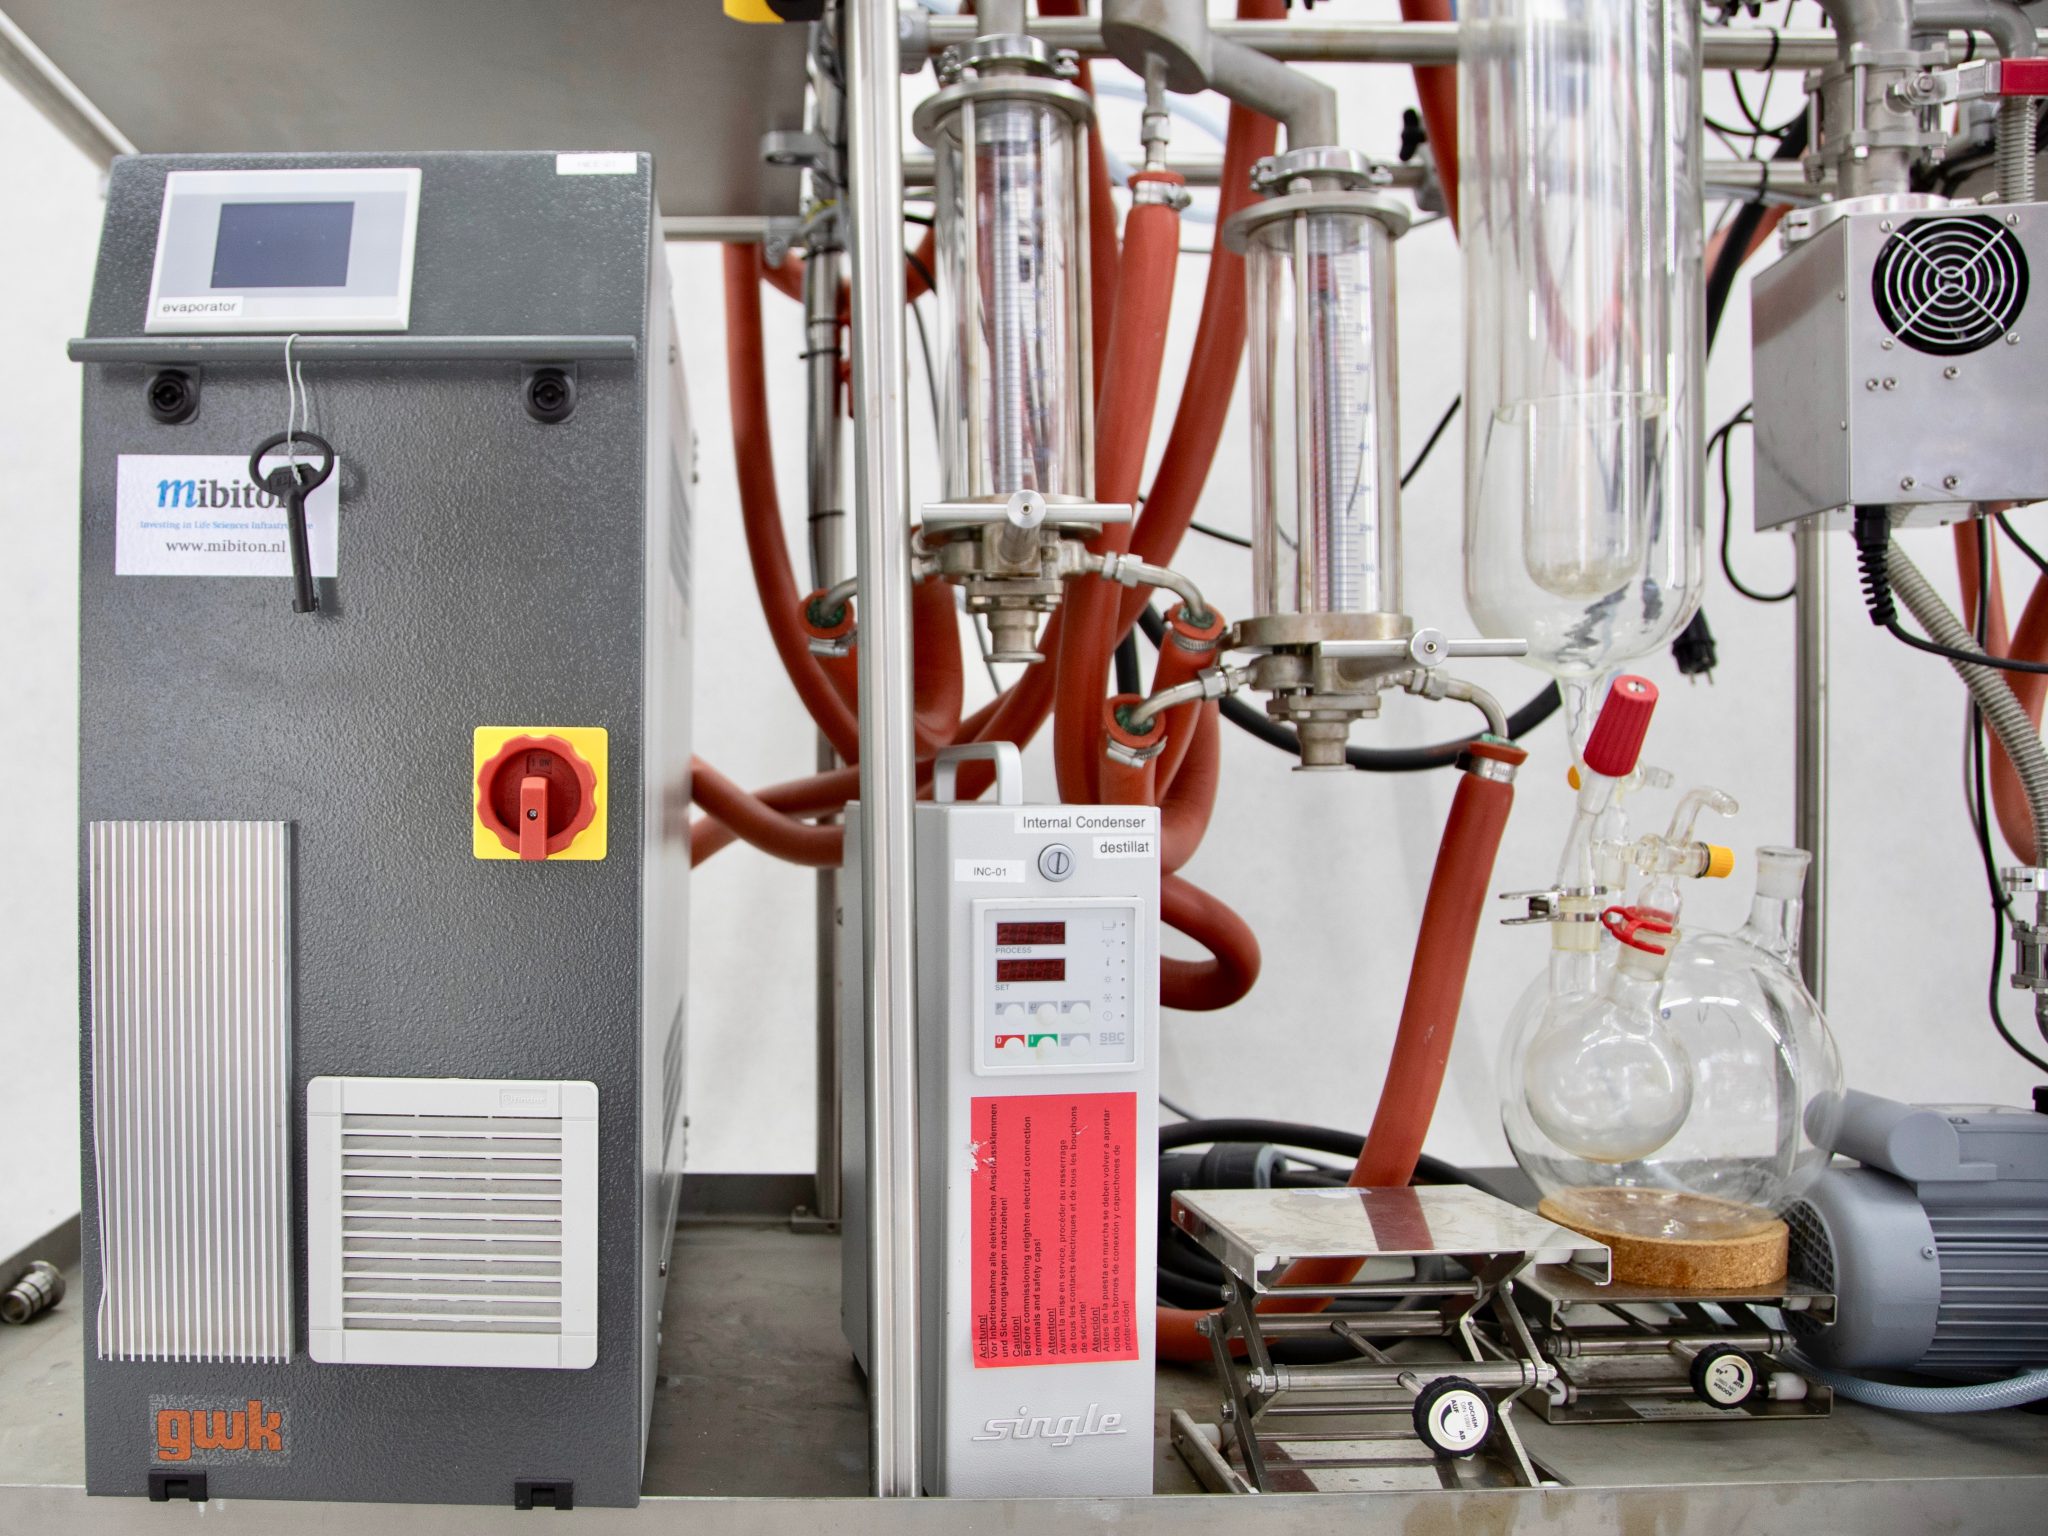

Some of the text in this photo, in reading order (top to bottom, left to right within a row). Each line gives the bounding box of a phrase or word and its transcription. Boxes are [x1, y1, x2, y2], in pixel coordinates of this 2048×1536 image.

[162, 302, 237, 313] evaporator
[140, 520, 180, 531] Investing
[183, 520, 192, 529] in
[195, 520, 210, 529] Life
[212, 520, 249, 530] Sciences
[166, 540, 286, 553] www.mibiton.nl
[1023, 815, 1146, 829] Internal Condenser
[1100, 841, 1149, 853] destillat
[973, 867, 1007, 877] INC-01
[1100, 1032, 1125, 1042] SBC
[1070, 1106, 1078, 1150] bouchons
[1103, 1109, 1111, 1140] apretar
[1113, 1145, 1120, 1156] de
[1059, 1140, 1067, 1187] resserrage
[1023, 1170, 1031, 1210] electrical
[1113, 1158, 1121, 1211] capuchones
[1059, 1190, 1066, 1200] au
[1070, 1190, 1076, 1200] de
[1102, 1181, 1110, 1207] deben
[1070, 1203, 1076, 1211] et
[1103, 1210, 1109, 1220] se
[989, 1195, 997, 1249] elektrischen
[1023, 1213, 1032, 1252] retighten
[989, 1252, 997, 1267] alle
[1058, 1245, 1066, 1279] service,
[1103, 1258, 1109, 1268] en
[1112, 1264, 1119, 1274] de
[1023, 1255, 1032, 1323] commissioning
[1059, 1282, 1065, 1292] en
[1102, 1271, 1110, 1300] puesta
[1000, 1254, 1008, 1337] Sicherungskappen
[1033, 1239, 1042, 1356] terminals and safety caps!
[989, 1270, 997, 1339] Inbetriebnahme
[1102, 1303, 1109, 1311] la
[1102, 1313, 1109, 1324] de
[978, 1315, 987, 1358] Achtung!
[1012, 1316, 1022, 1357] Caution!
[1047, 1308, 1057, 1355] Attention!
[1091, 1307, 1101, 1352] Atención!
[1023, 1326, 1031, 1356] Before
[1070, 1343, 1077, 1354] de
[1080, 1343, 1087, 1353] de
[990, 1342, 998, 1358] Vor
[1451, 1400, 1459, 1414] AUF
[1467, 1401, 1478, 1429] BOCHEM
[157, 1399, 282, 1461] gwk
[971, 1402, 1128, 1447] single
[1459, 1430, 1466, 1441] AB
